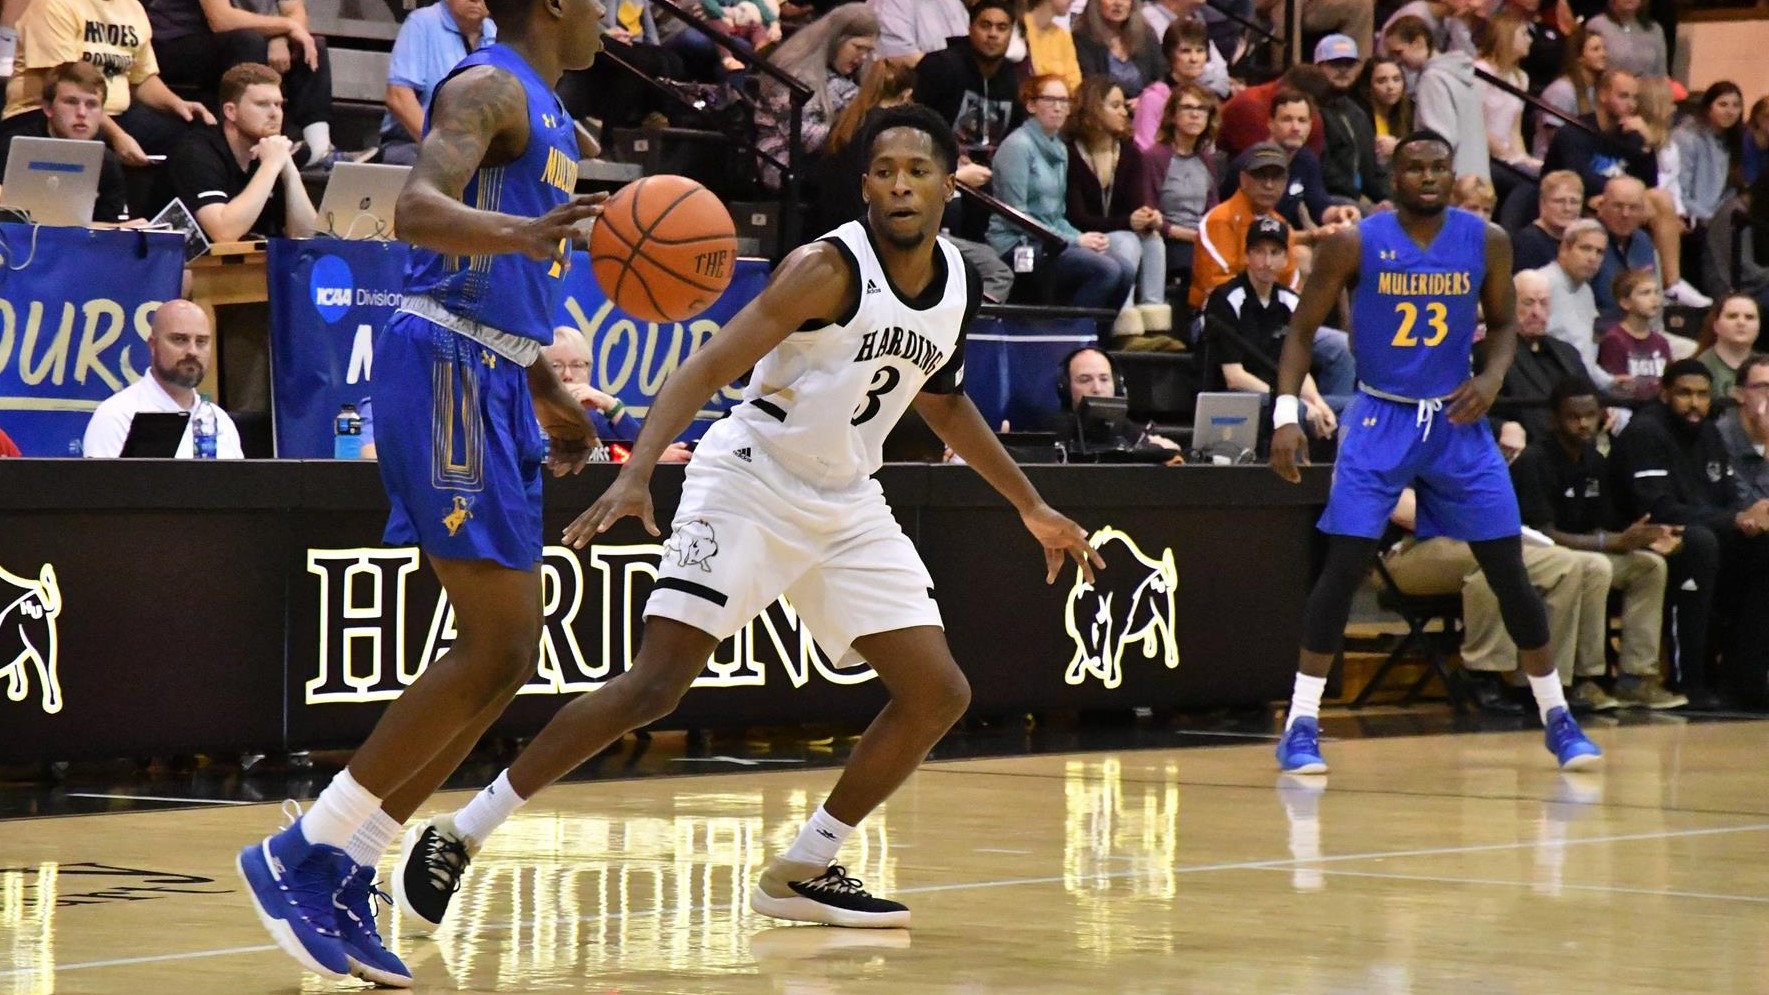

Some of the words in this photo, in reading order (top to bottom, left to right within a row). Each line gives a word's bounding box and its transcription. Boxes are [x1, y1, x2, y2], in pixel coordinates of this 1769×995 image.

[694, 249, 728, 279] THE
[316, 287, 352, 307] NCAA
[1378, 271, 1471, 295] MULERIDERS
[1391, 302, 1449, 347] 23
[853, 326, 943, 376] HARDING
[850, 365, 900, 427] 3
[20, 600, 44, 620] HU
[305, 544, 879, 704] HRDN
